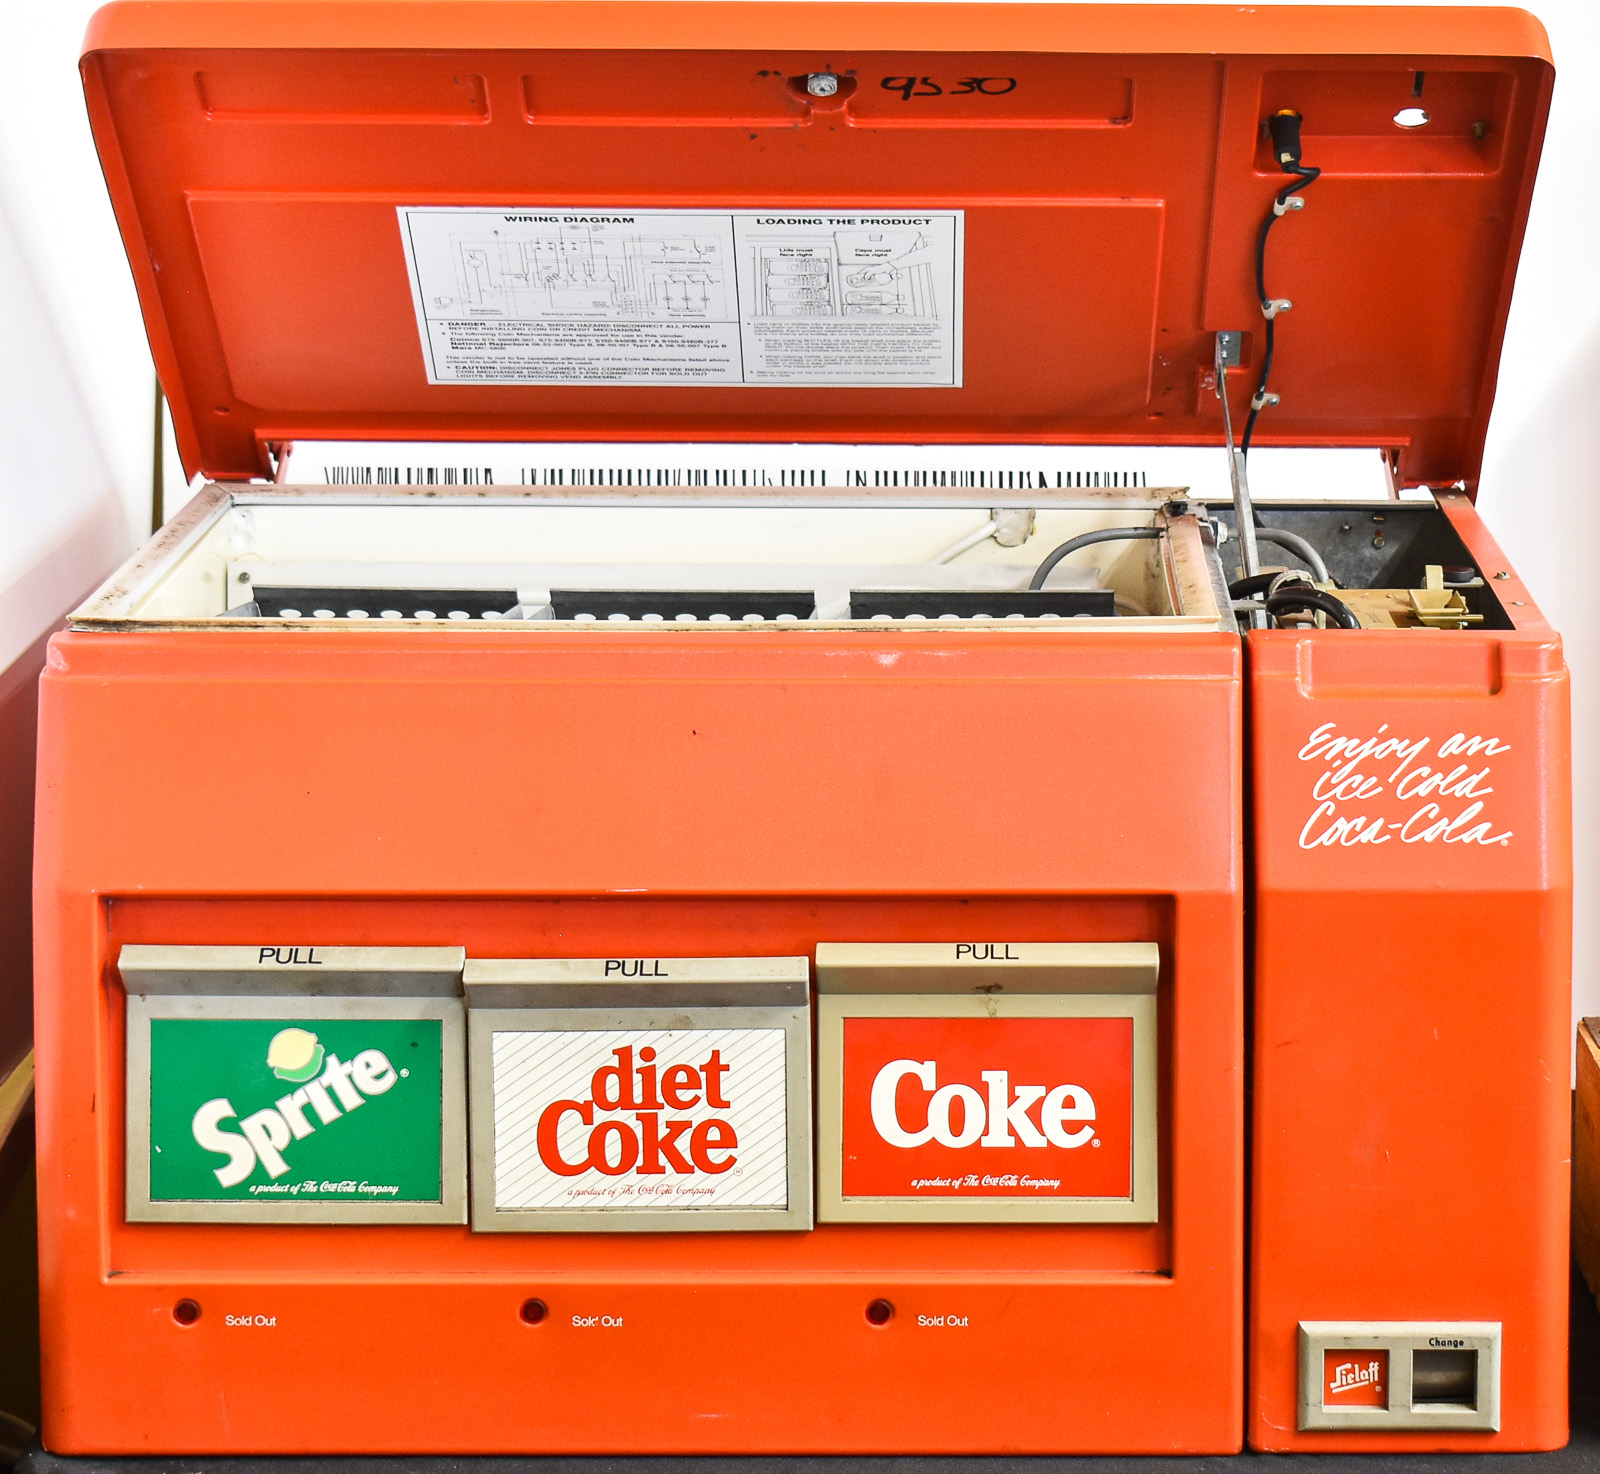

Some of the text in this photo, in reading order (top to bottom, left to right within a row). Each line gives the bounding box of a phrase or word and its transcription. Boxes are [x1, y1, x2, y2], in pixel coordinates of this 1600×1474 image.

[1297, 722, 1511, 783] Enjoy an
[1312, 759, 1384, 801] ice
[1298, 800, 1513, 849] Coca-Cola
[258, 947, 323, 965] PULL
[955, 943, 1020, 961] PULL
[604, 959, 669, 977] PULL
[591, 1044, 731, 1111] diet
[870, 1058, 1097, 1149] Coke
[191, 1048, 398, 1188] Sprite
[536, 1099, 738, 1177] Coke
[255, 1183, 289, 1195] product
[290, 1183, 301, 1195] of
[301, 1180, 318, 1192] The
[358, 1181, 399, 1195] Company
[917, 1176, 951, 1189] product
[951, 1177, 963, 1189] of
[963, 1174, 980, 1186] The
[1019, 1174, 1061, 1189] Company
[573, 1187, 606, 1199] product
[608, 1188, 619, 1198] of
[619, 1184, 635, 1195] The
[676, 1184, 716, 1196] Company
[225, 1315, 277, 1327] Sold Out
[601, 1315, 623, 1327] Out
[917, 1315, 969, 1327] Sold Out
[1428, 1337, 1465, 1348] Change
[1329, 1361, 1380, 1388] Sielaff
